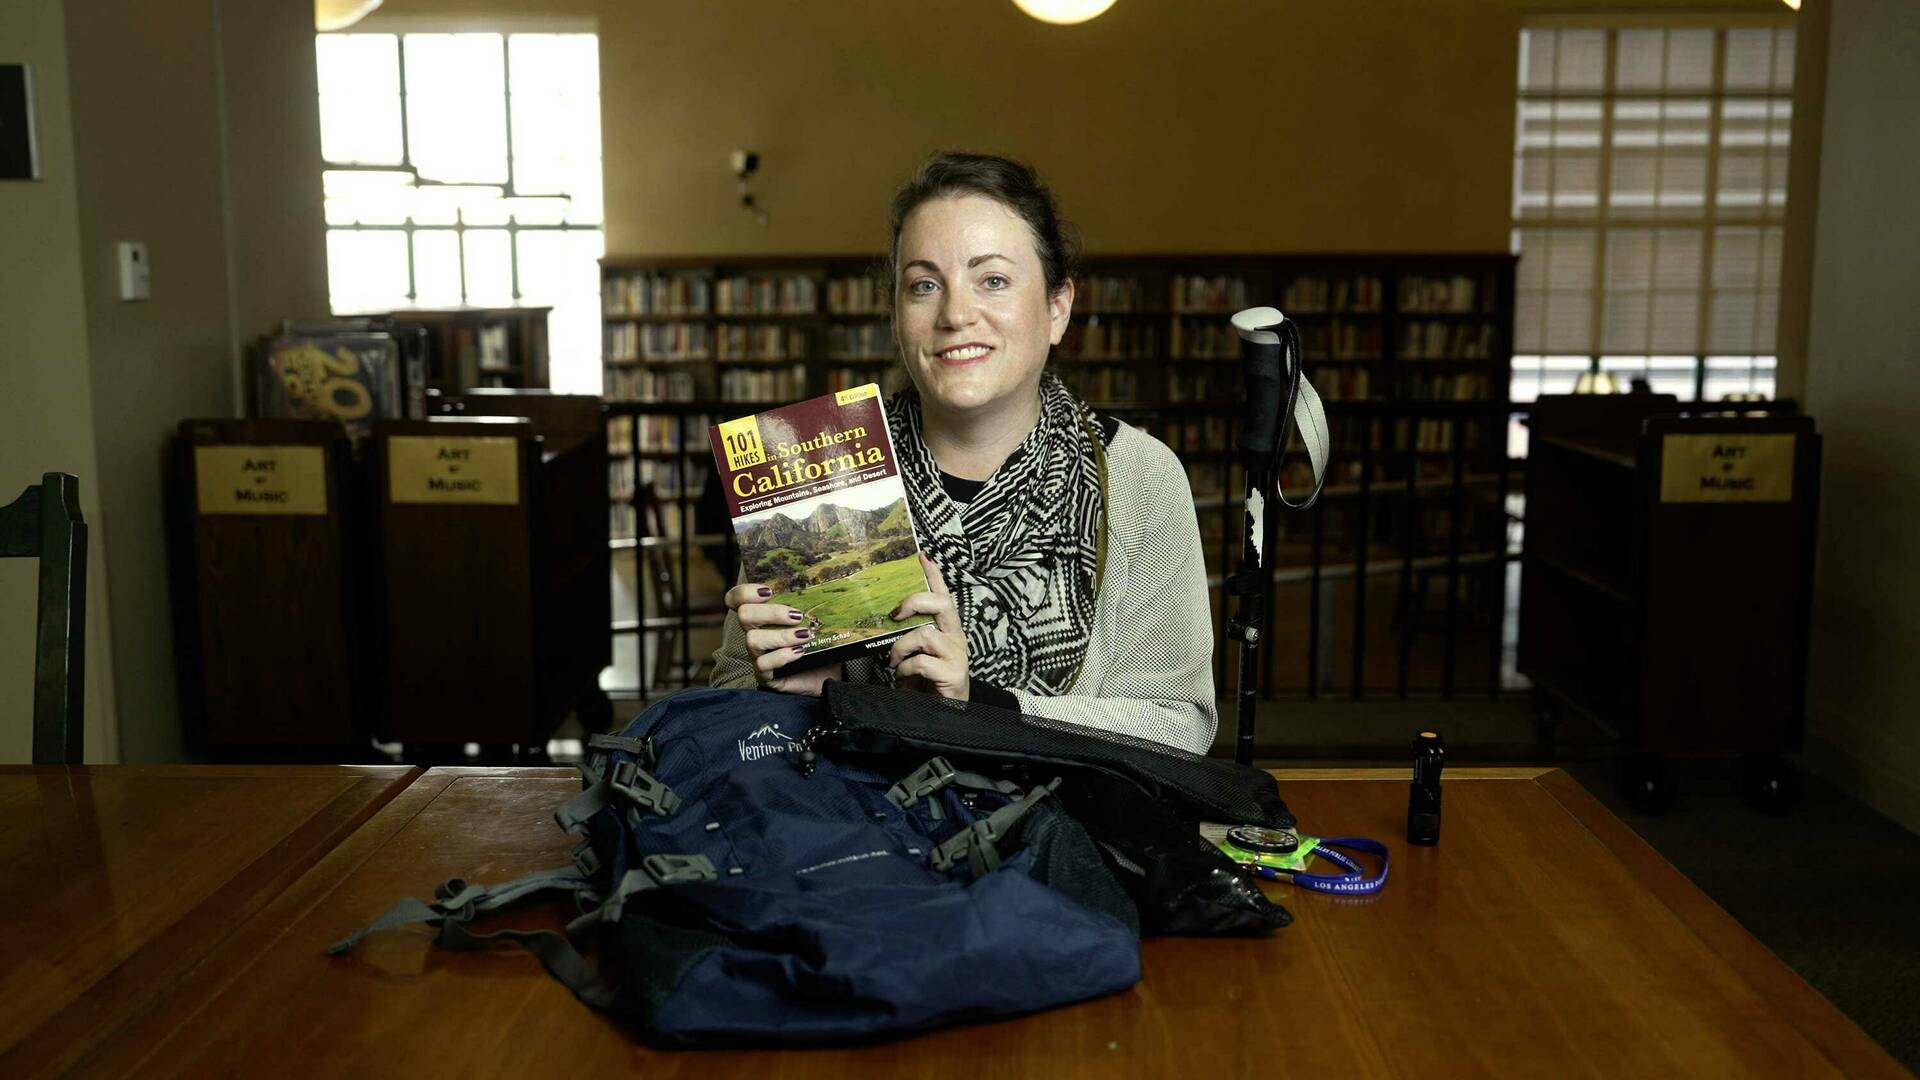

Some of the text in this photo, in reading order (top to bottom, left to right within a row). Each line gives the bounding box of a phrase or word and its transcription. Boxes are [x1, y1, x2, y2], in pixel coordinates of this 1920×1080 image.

[727, 429, 758, 455] 101
[767, 426, 868, 462] in Southern
[732, 443, 886, 498] California
[733, 452, 761, 468] HIKES
[740, 499, 773, 513] Exploring
[773, 489, 813, 504] Mountains,
[849, 475, 862, 485] and
[862, 468, 888, 481] Desert
[817, 637, 832, 646] Jerry
[832, 631, 851, 642] Schad
[1314, 881, 1375, 891] LOS ANGELES
